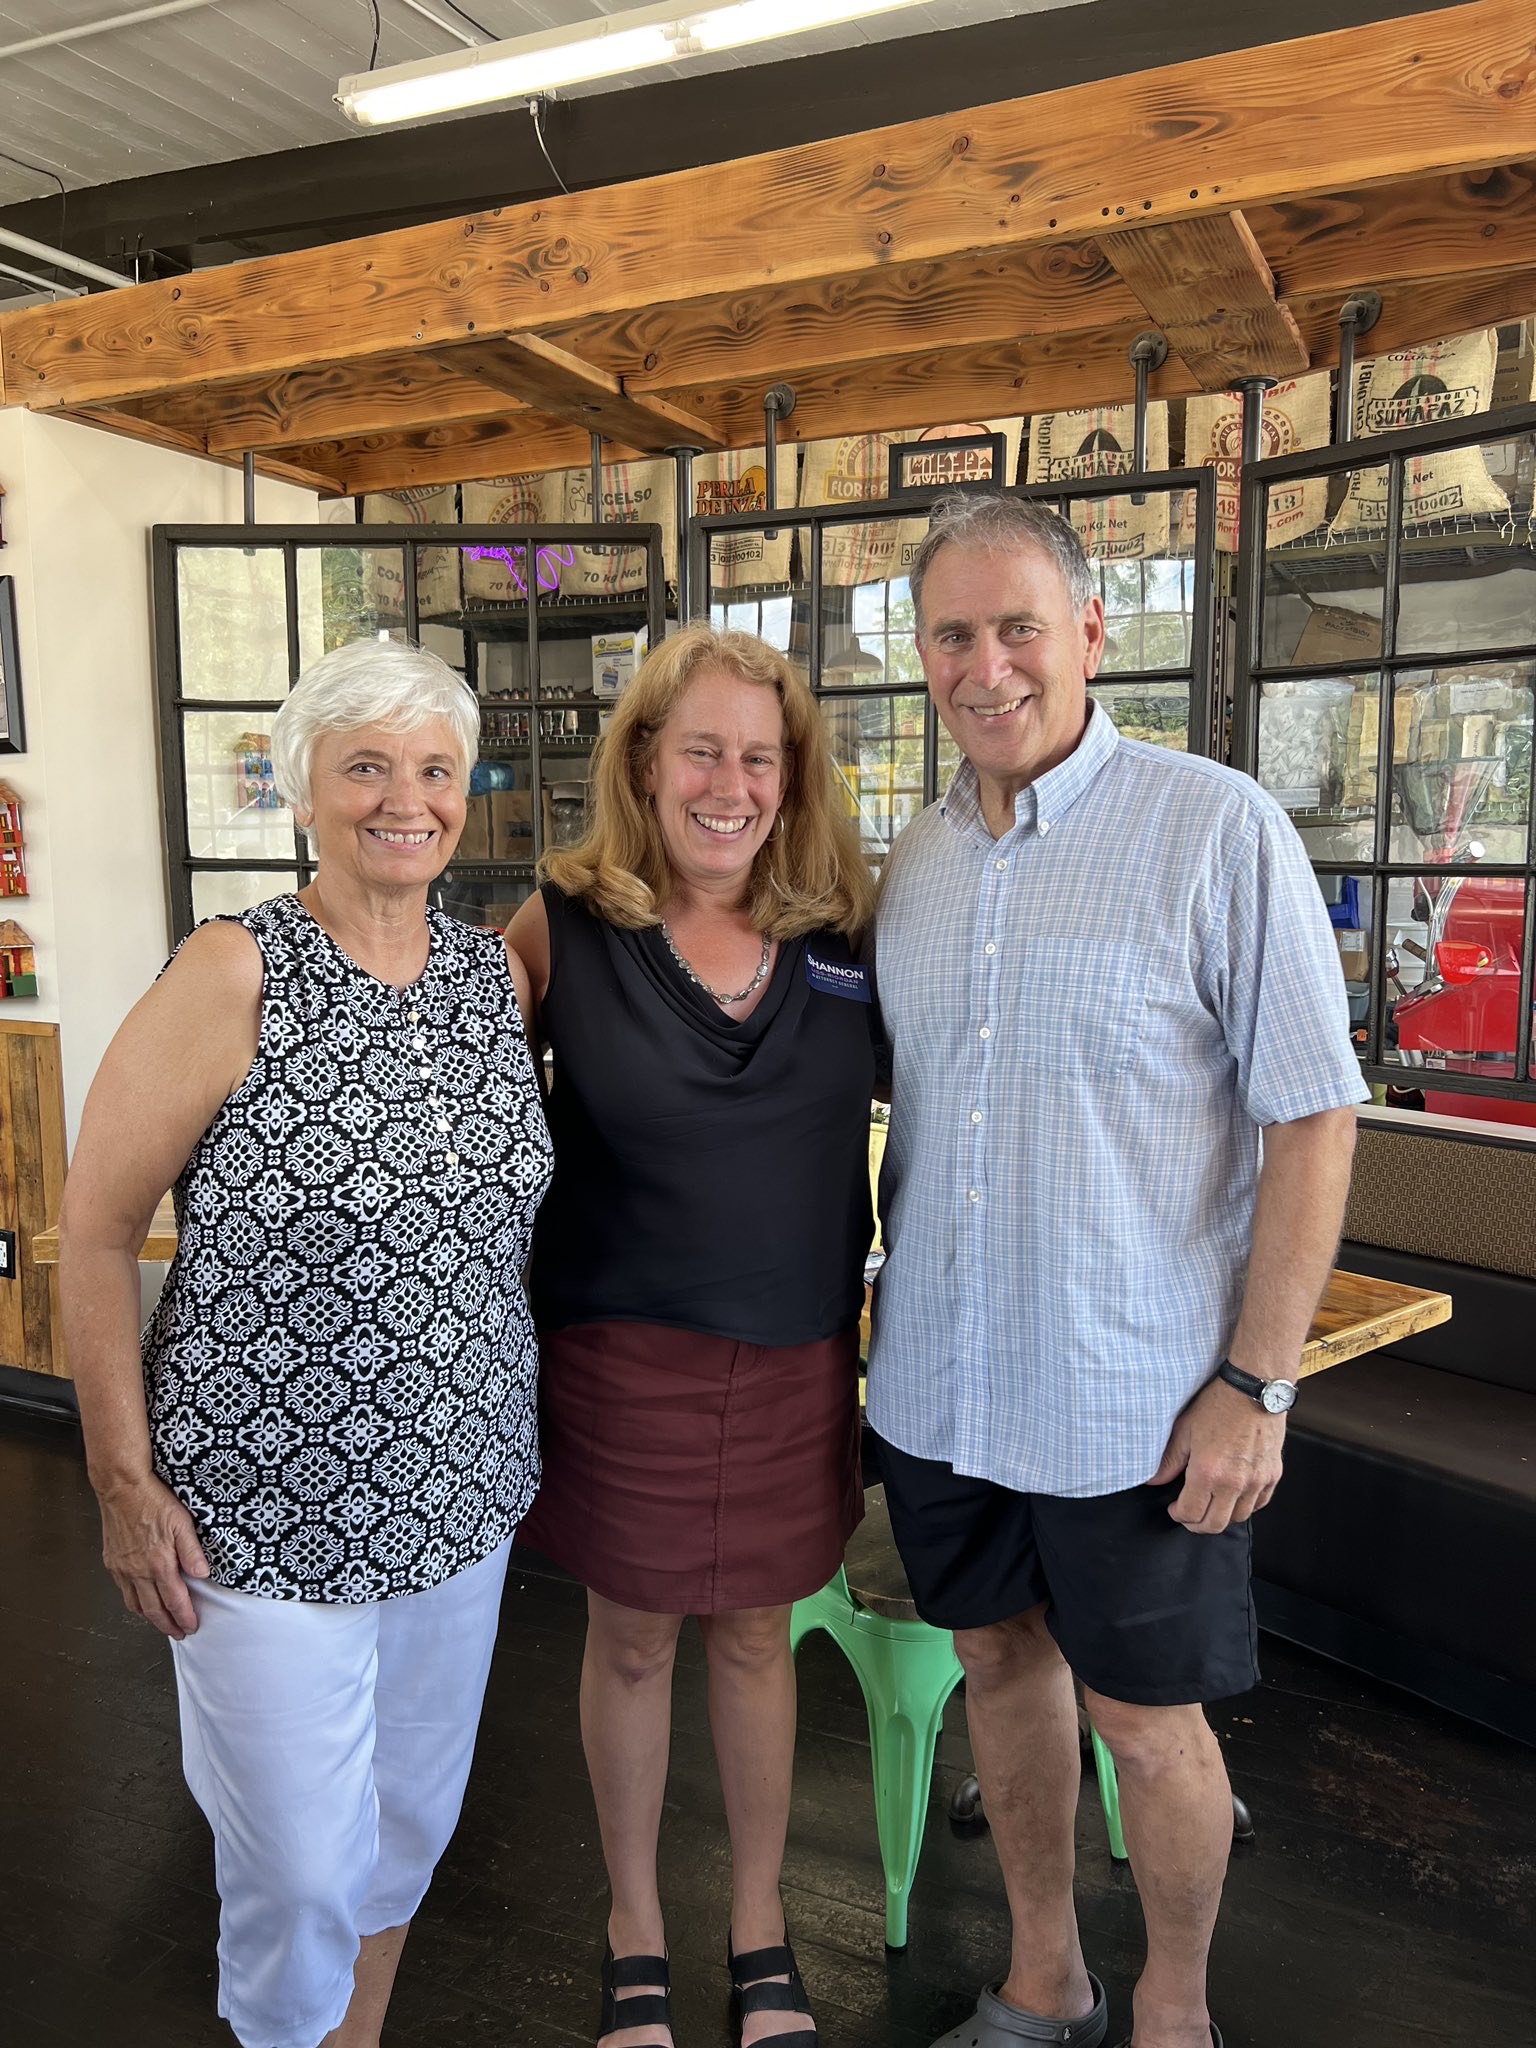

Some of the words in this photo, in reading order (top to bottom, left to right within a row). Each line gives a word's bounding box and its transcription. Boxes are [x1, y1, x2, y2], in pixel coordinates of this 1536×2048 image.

[1412, 471, 1434, 484] Net
[831, 480, 862, 497] FLOR
[586, 488, 652, 506] ECELSO
[604, 508, 639, 523] CAFÉ
[1108, 519, 1128, 529] Net
[904, 549, 911, 561] 3
[583, 571, 599, 582] 70
[622, 566, 642, 579] Net
[807, 953, 864, 980] SHANNON
